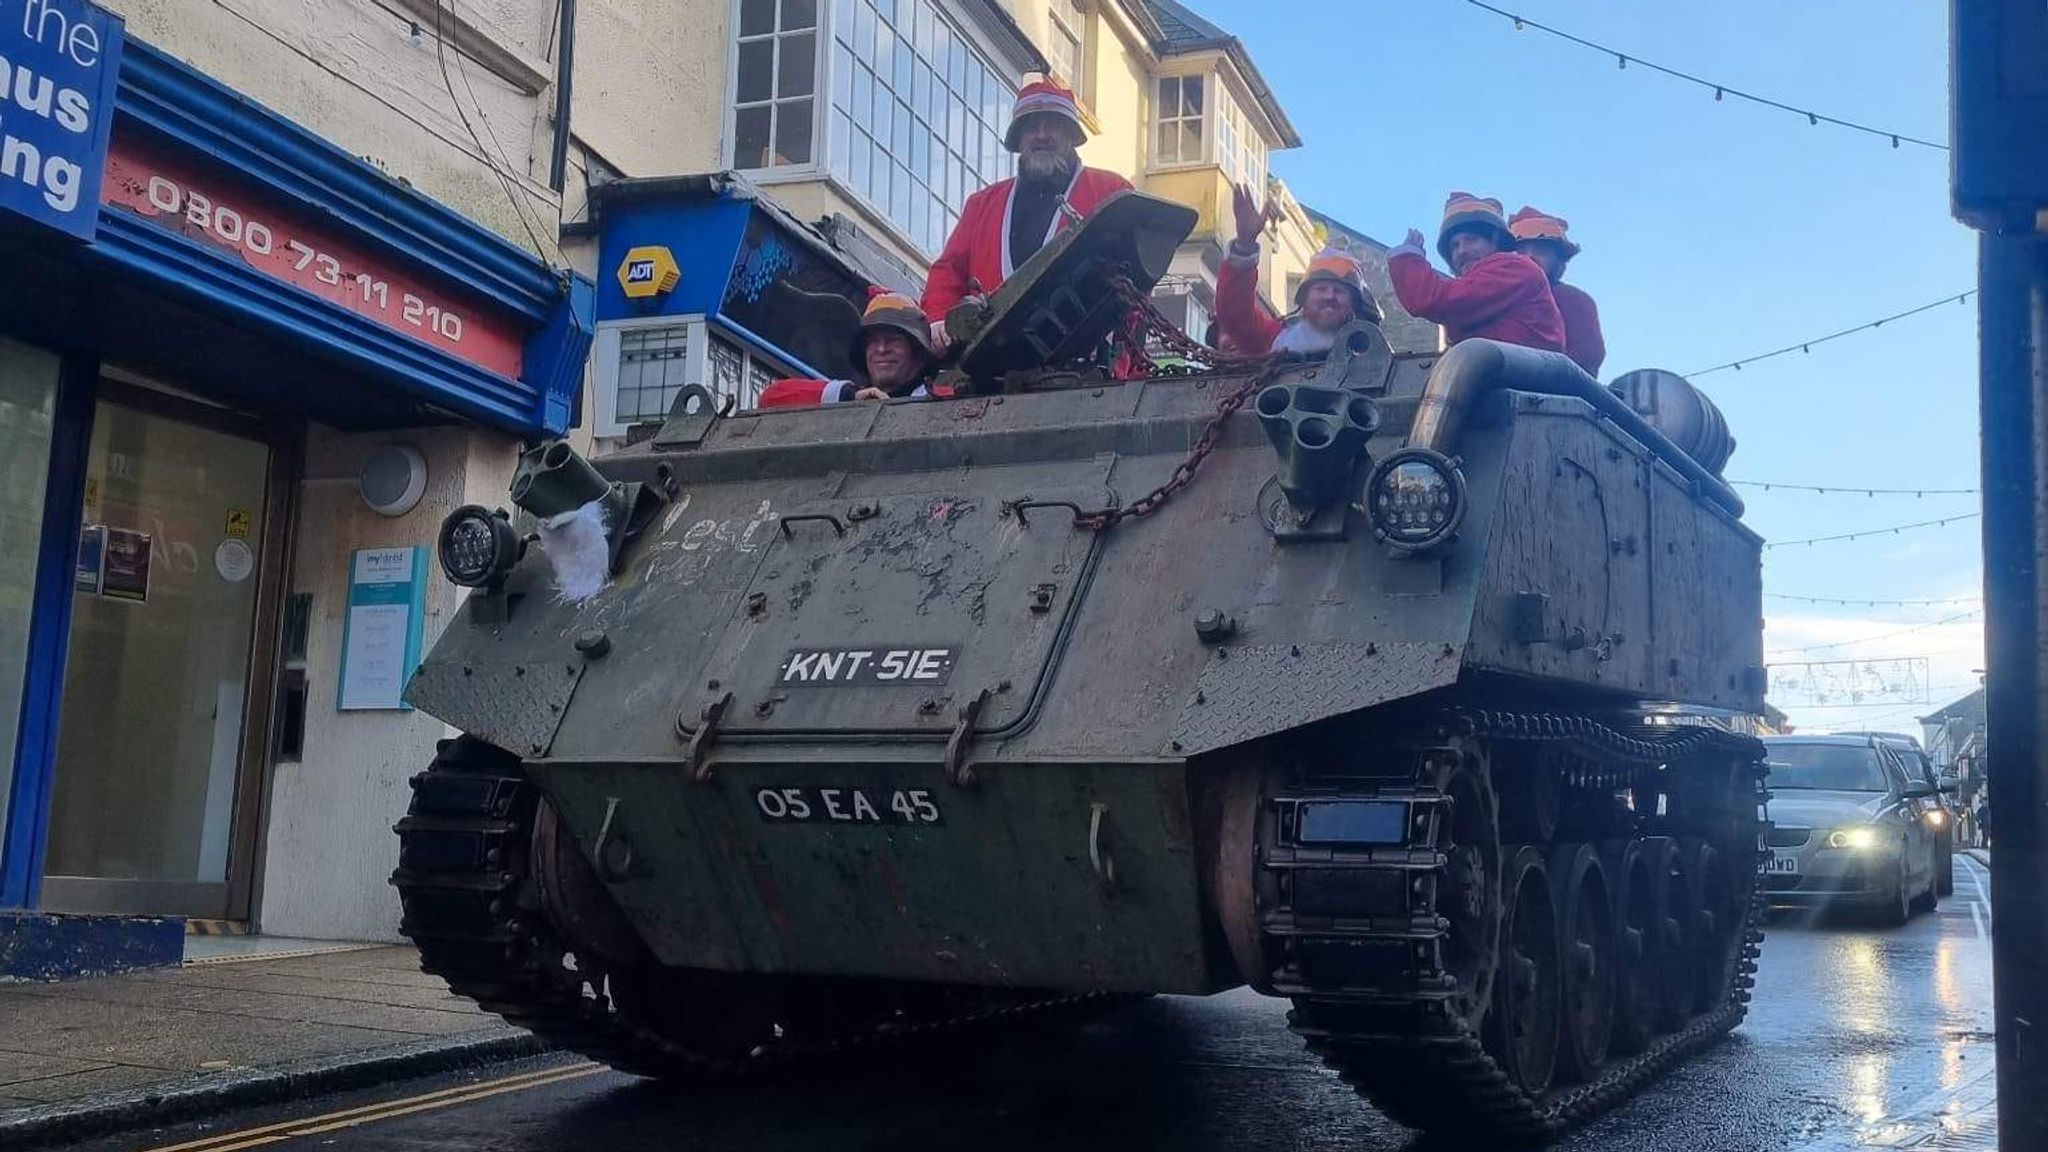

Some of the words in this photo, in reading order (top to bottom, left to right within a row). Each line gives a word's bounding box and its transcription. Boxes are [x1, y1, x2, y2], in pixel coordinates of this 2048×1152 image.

[23, 0, 99, 67] the
[0, 116, 82, 213] ng
[148, 175, 273, 255] 0800
[290, 240, 341, 286] 73
[356, 274, 388, 309] 11
[401, 293, 462, 342] 210
[628, 263, 652, 280] ADT
[783, 651, 873, 682] KNT
[820, 789, 881, 821] EA
[891, 790, 939, 823] 45
